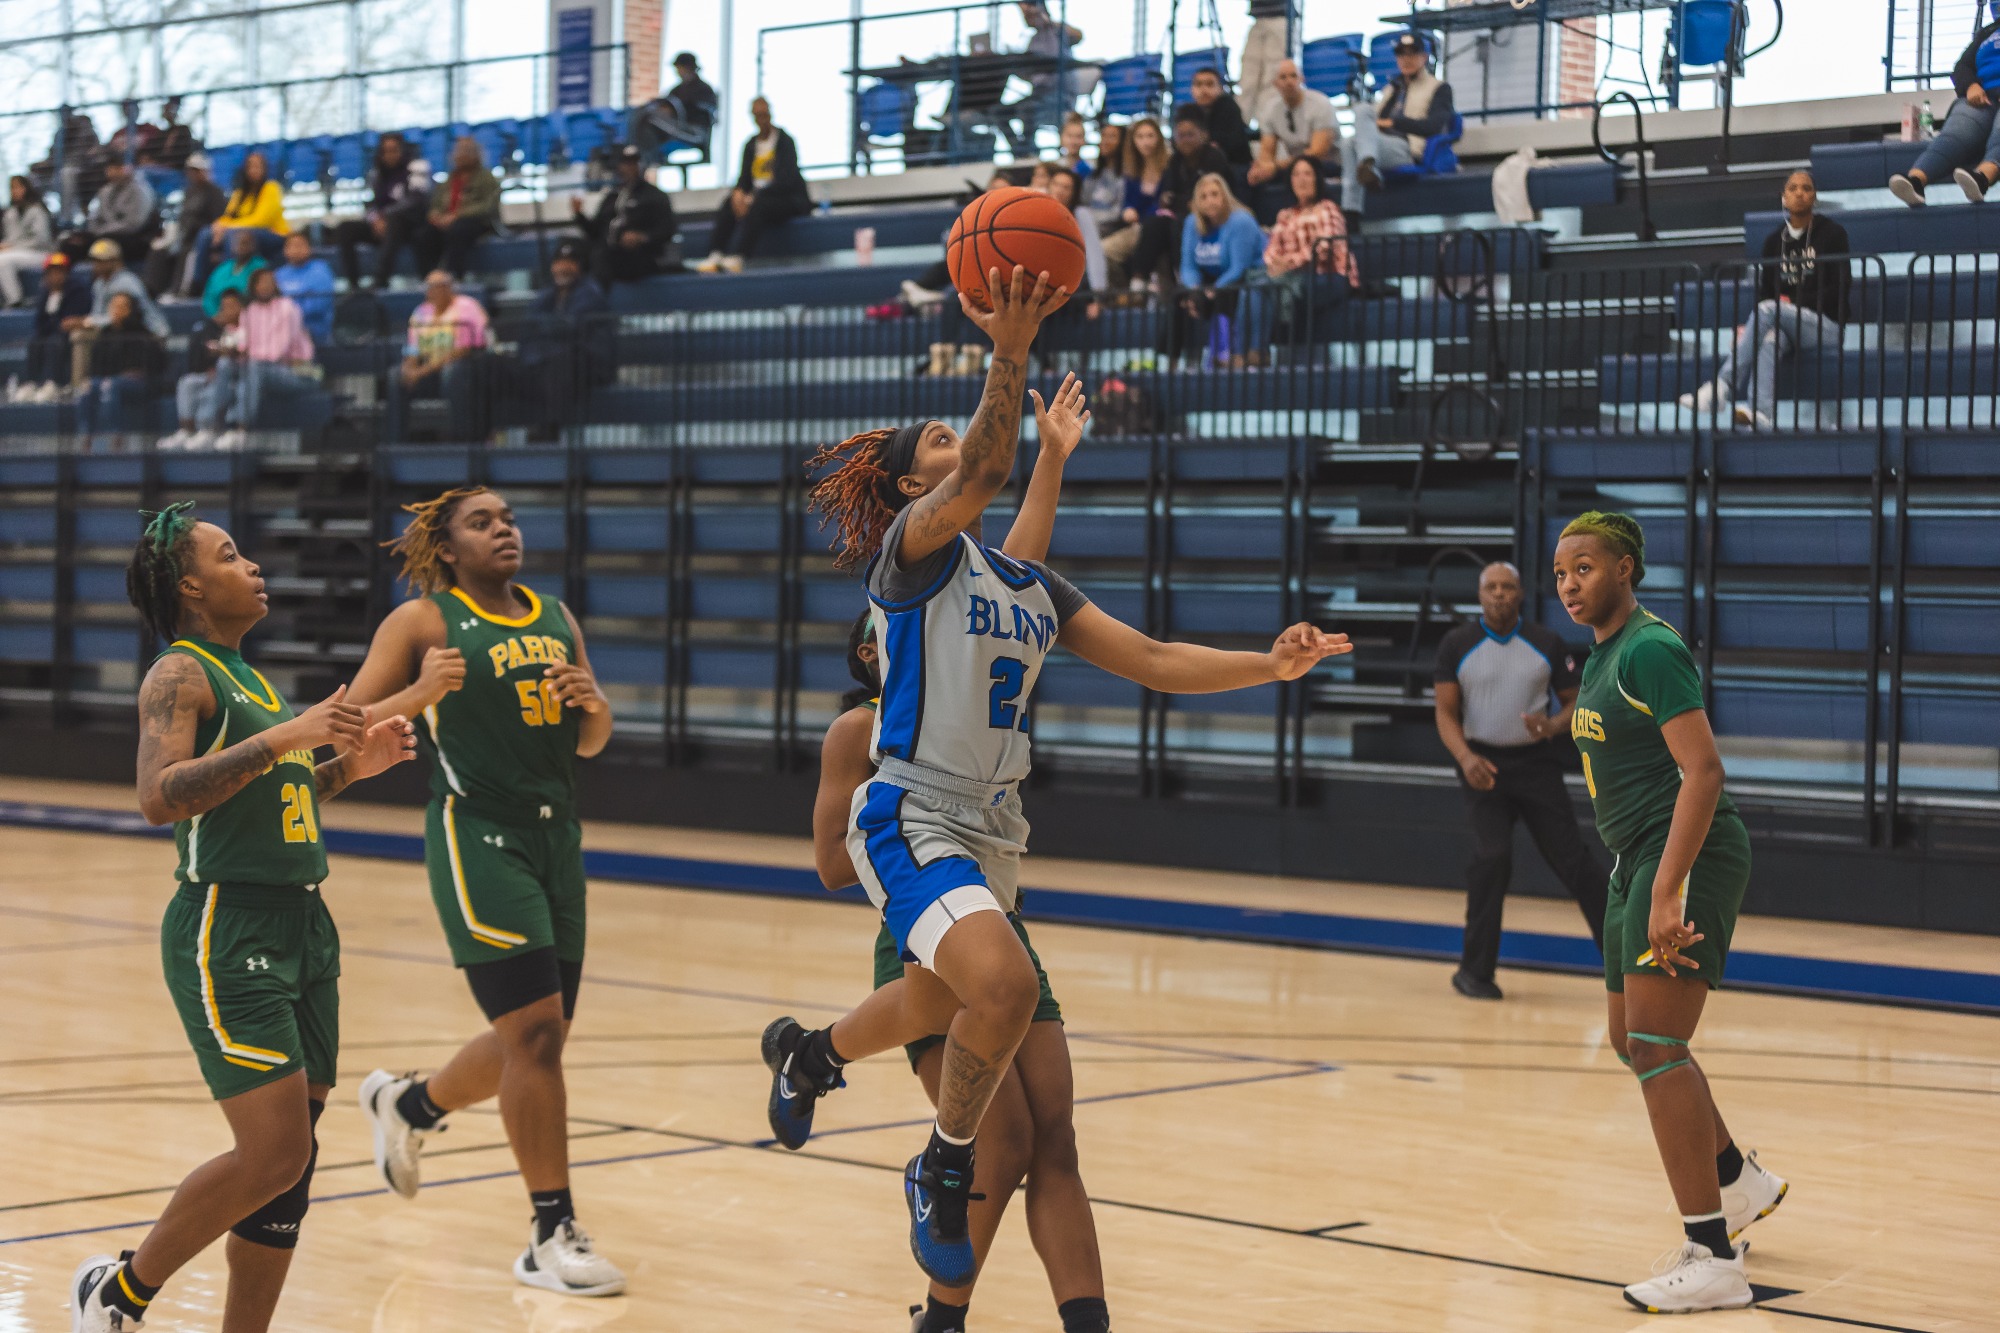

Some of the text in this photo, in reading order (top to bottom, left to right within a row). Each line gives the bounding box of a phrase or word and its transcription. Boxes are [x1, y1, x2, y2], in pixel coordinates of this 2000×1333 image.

[488, 635, 568, 678] PARIS
[514, 678, 562, 727] 50
[281, 783, 318, 844] 20
